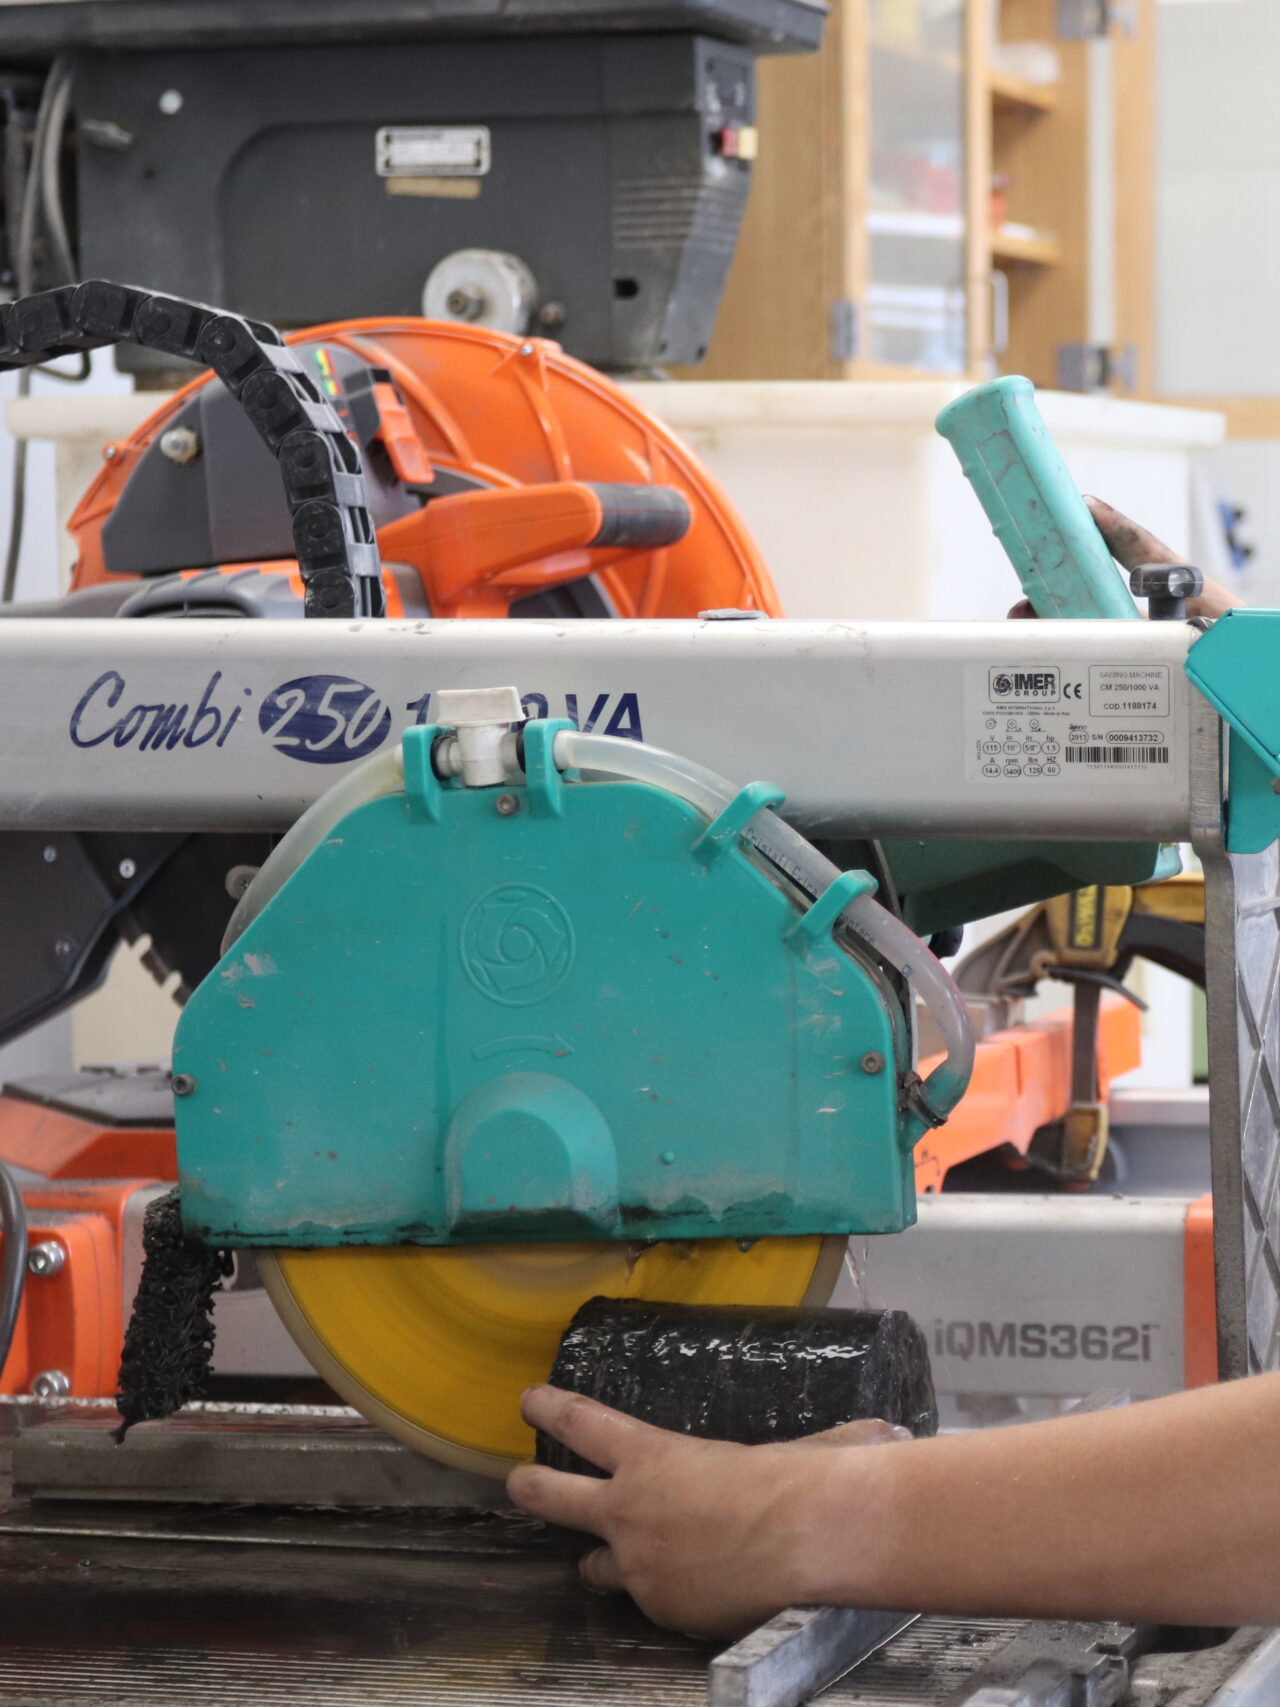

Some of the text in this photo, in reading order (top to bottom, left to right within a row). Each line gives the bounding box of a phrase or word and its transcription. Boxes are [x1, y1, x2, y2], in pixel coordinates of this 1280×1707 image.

[1014, 673, 1056, 690] IMER
[1115, 683, 1147, 691] 250/1000
[1122, 702, 1157, 710] 1188174
[69, 670, 252, 751] Combi
[268, 682, 385, 752] 250
[565, 693, 644, 742] VA
[1108, 733, 1158, 742] 0009413732
[1005, 758, 1019, 766] rpm
